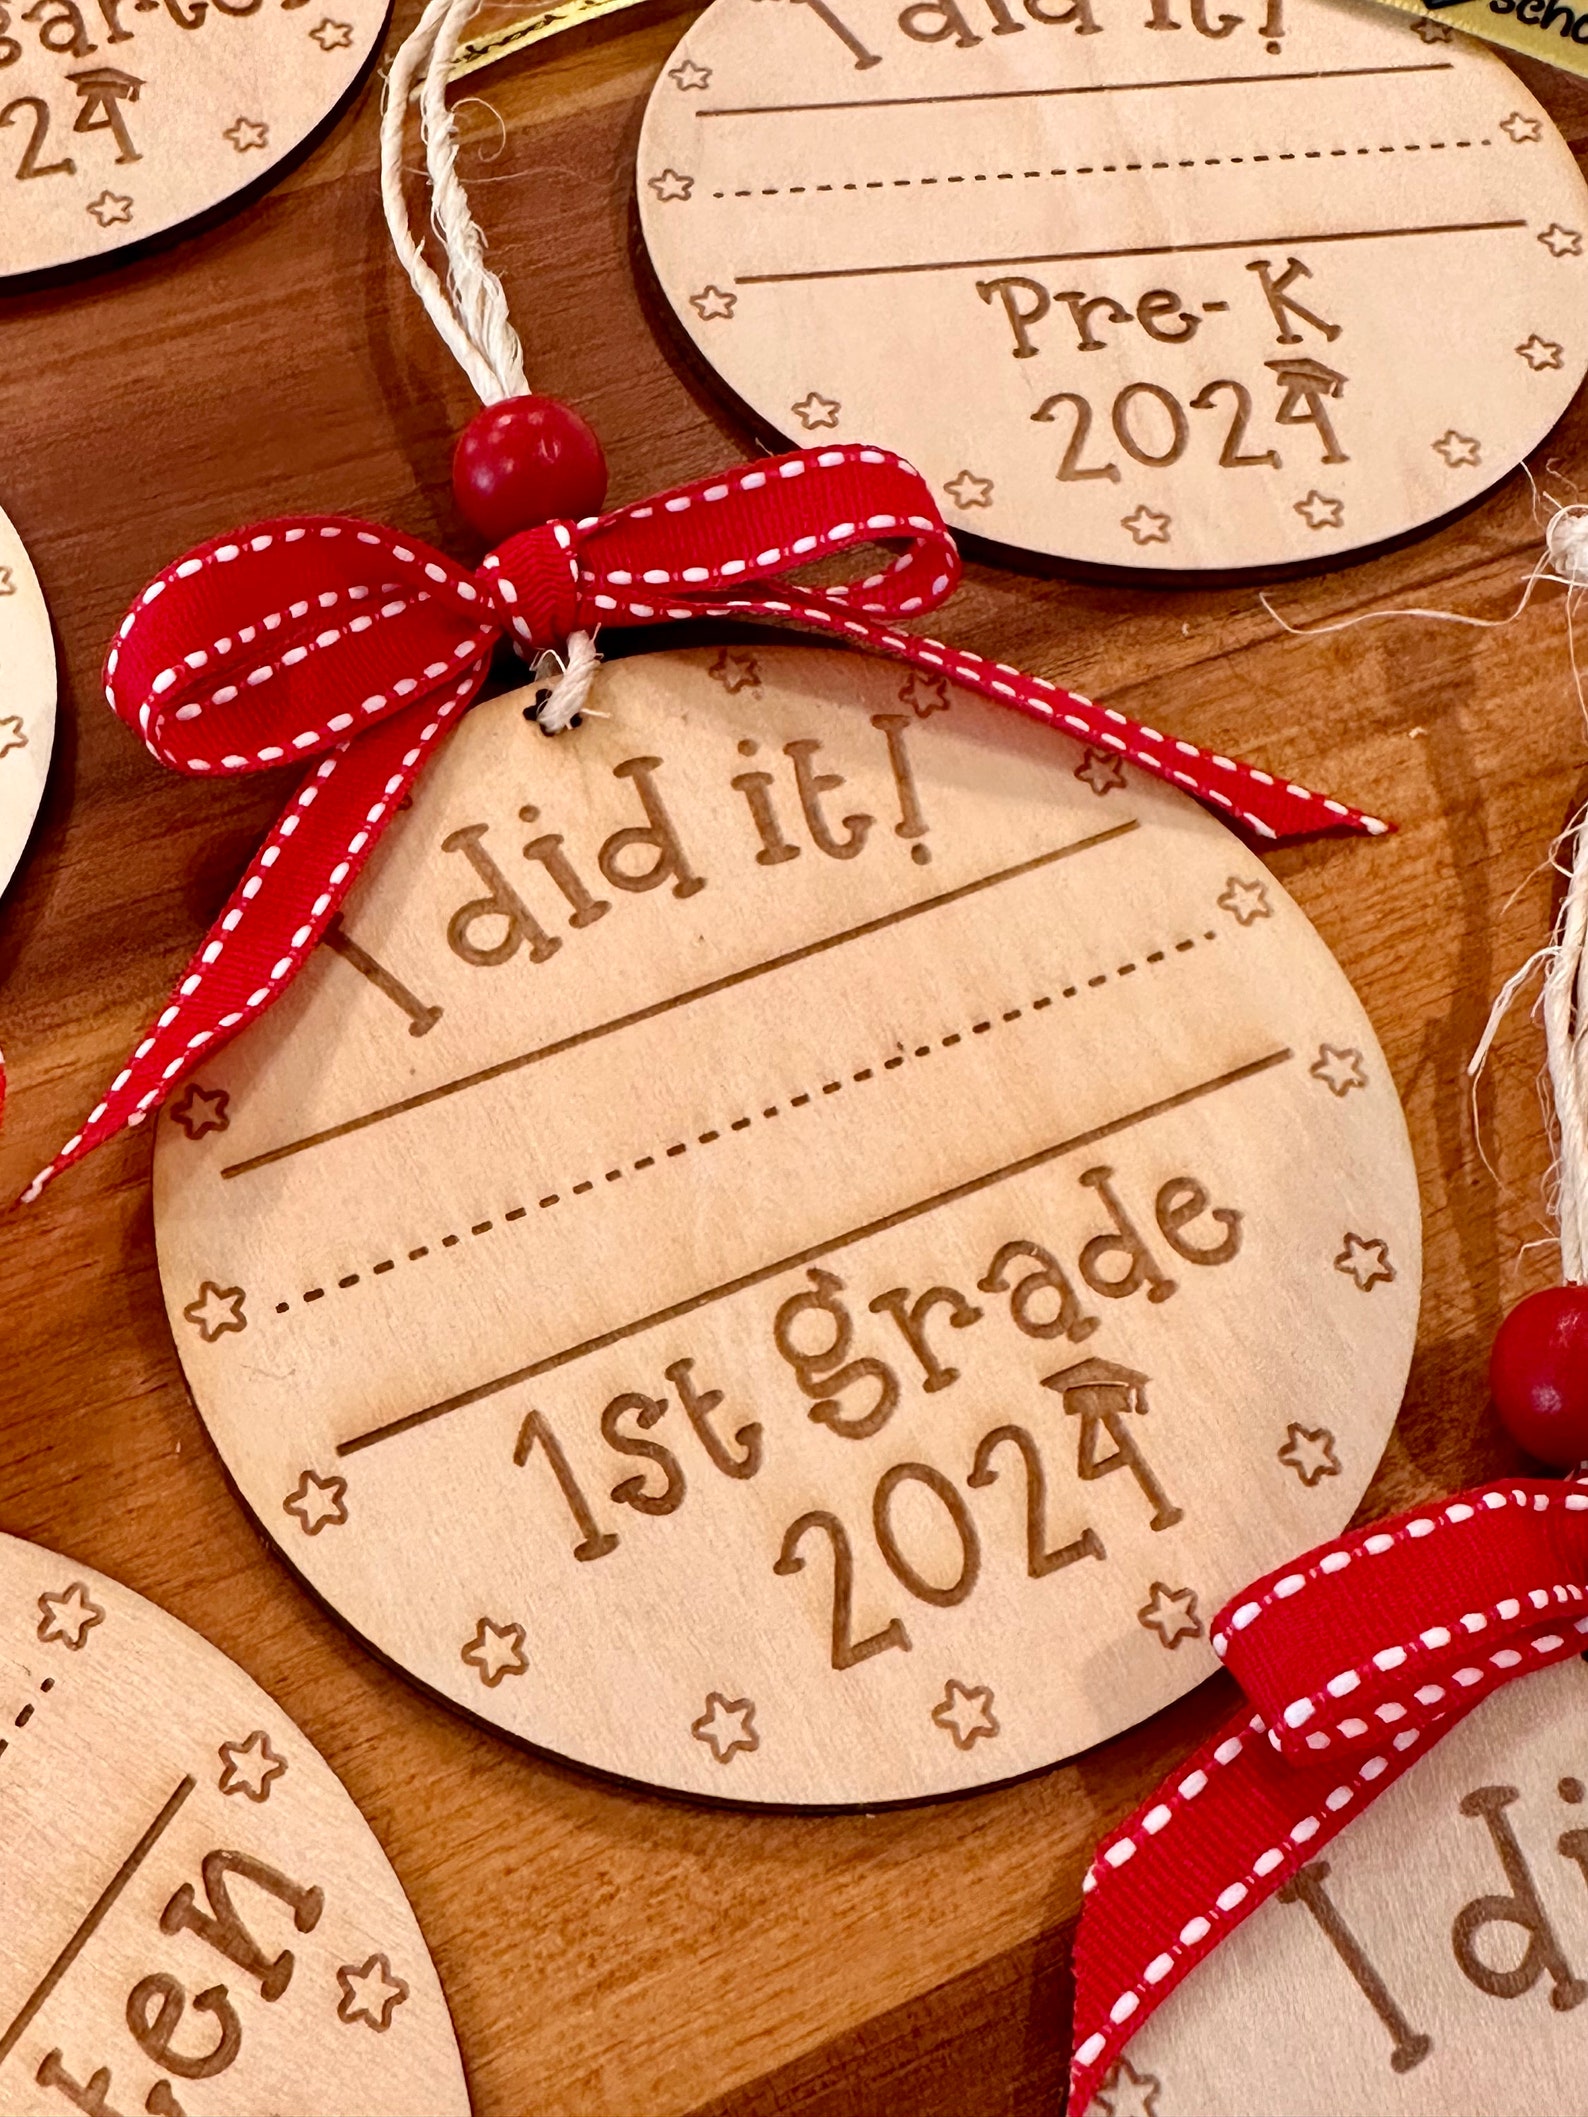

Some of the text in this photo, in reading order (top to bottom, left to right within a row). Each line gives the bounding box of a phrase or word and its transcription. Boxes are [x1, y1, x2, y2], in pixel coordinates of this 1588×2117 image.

[976, 257, 1342, 359] Pre-K
[1030, 374, 1351, 483] 2024
[326, 714, 932, 1037] I did it!
[513, 1165, 1244, 1562] 1st grade
[774, 1396, 1184, 1670] 2024
[1277, 1861, 1433, 2074] I
